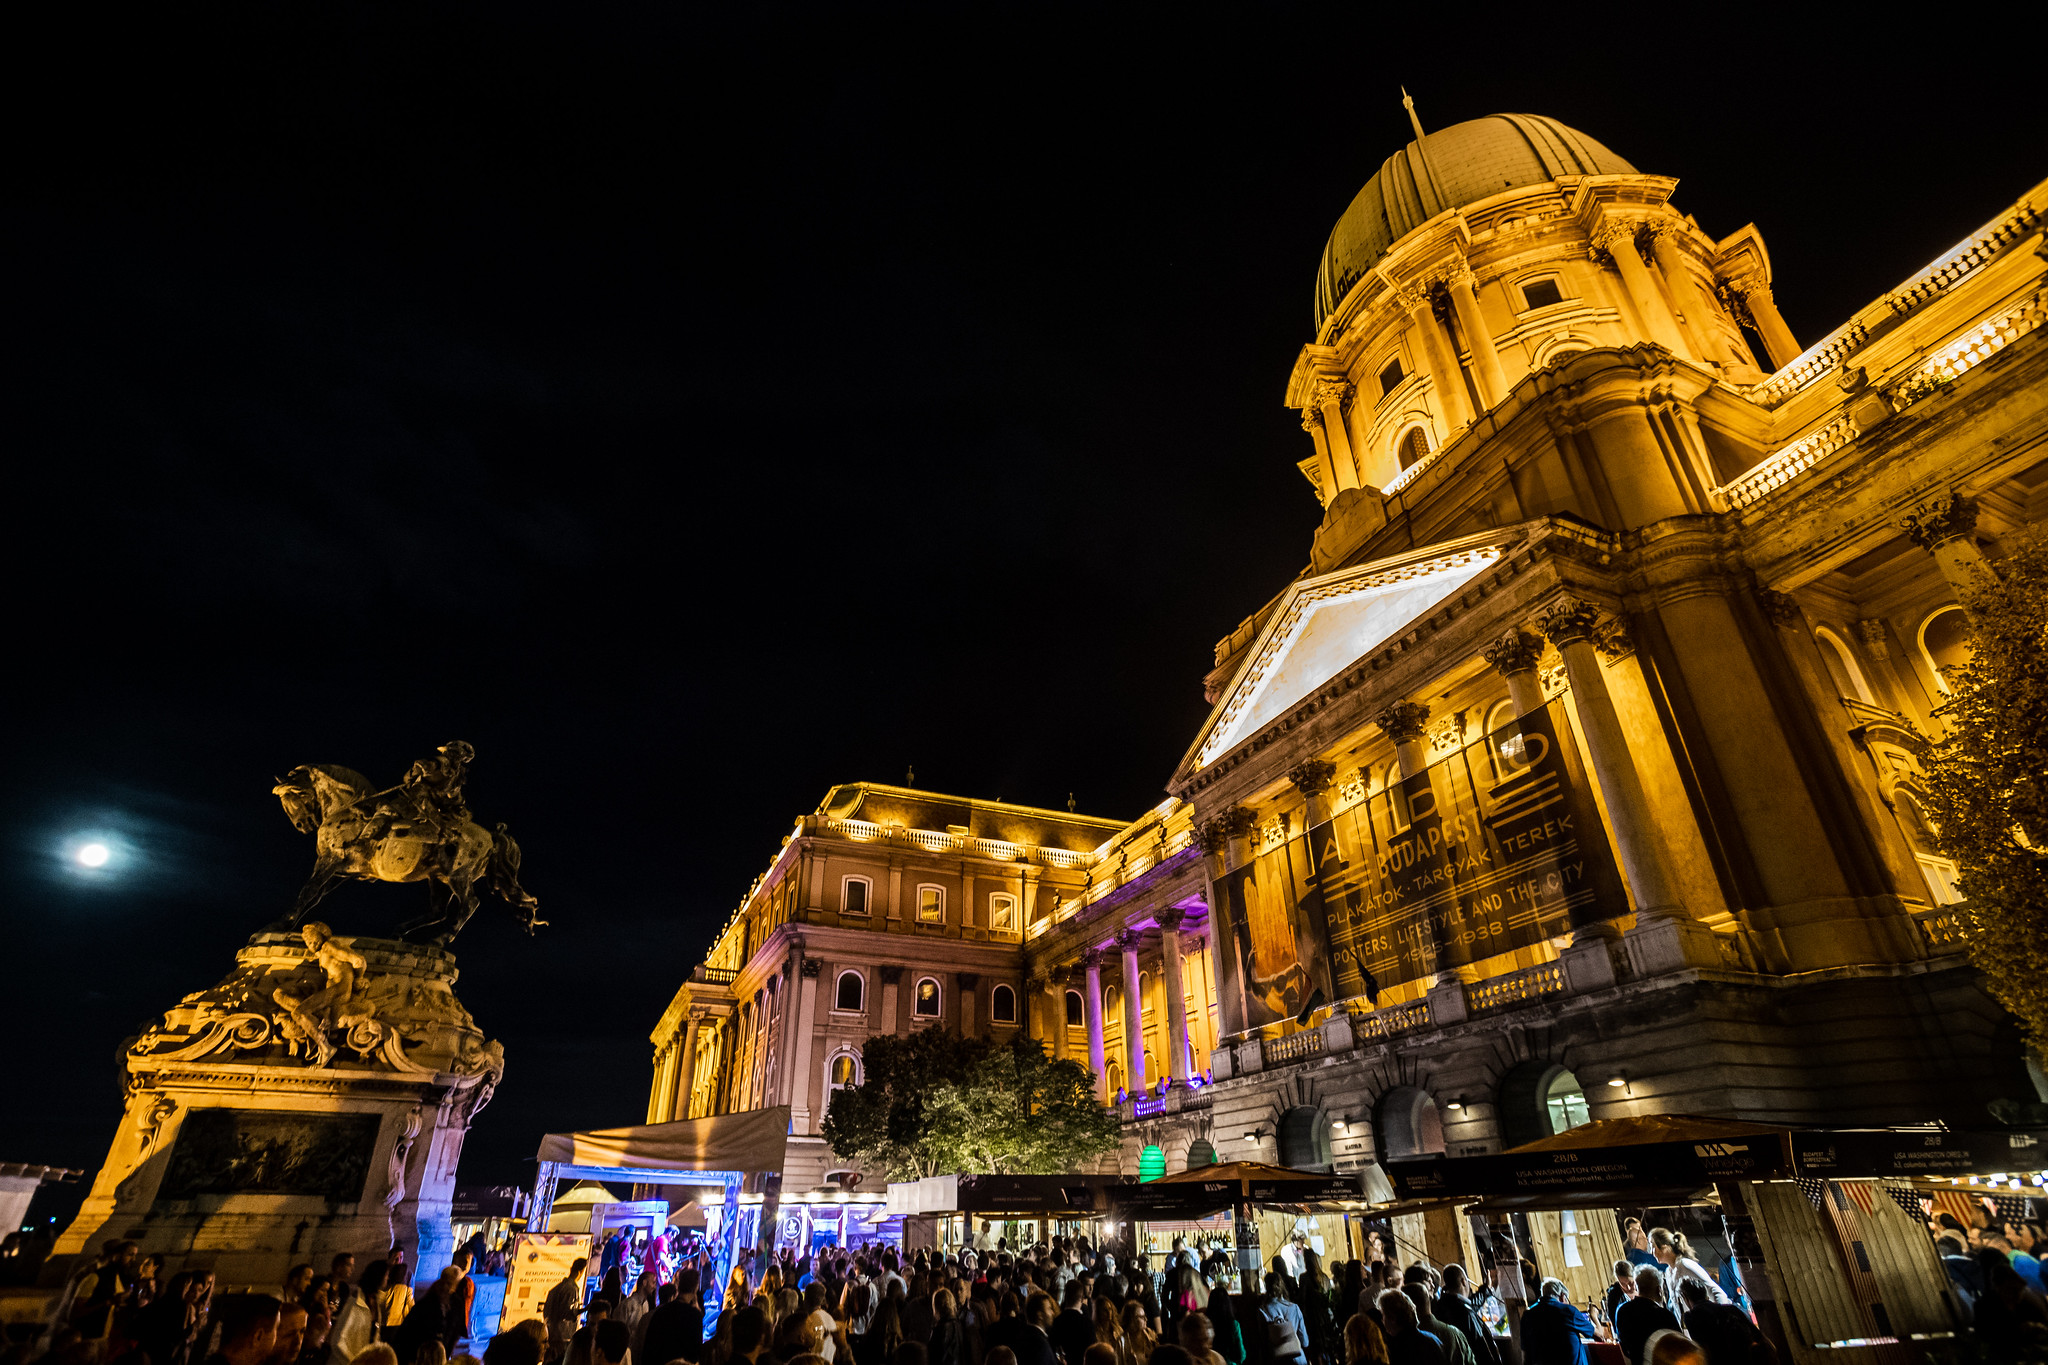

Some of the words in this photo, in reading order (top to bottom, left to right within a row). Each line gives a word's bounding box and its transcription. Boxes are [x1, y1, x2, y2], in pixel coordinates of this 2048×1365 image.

[1319, 806, 1393, 869] ART
[1408, 732, 1549, 824] DECO
[1327, 885, 1405, 927] PLAKÁTOK
[1412, 848, 1492, 891] TÁRGYAK
[1502, 814, 1574, 853] TEREK
[1376, 806, 1482, 879] BUDAPEST
[1333, 935, 1392, 967] POSTERS,
[1396, 905, 1466, 945] LIFESTYLE
[1472, 893, 1503, 918] AND
[1506, 879, 1541, 904] THE
[1546, 860, 1584, 890] CITY
[1402, 920, 1504, 964] 1925-1938
[1515, 1169, 1533, 1178] USA
[1534, 1166, 1590, 1178] WASHINGTON
[1590, 1163, 1628, 1174] OREGON
[1531, 1176, 1566, 1186] columbia,
[1605, 1172, 1635, 1182] dundee
[1552, 1153, 1579, 1164] 28/B
